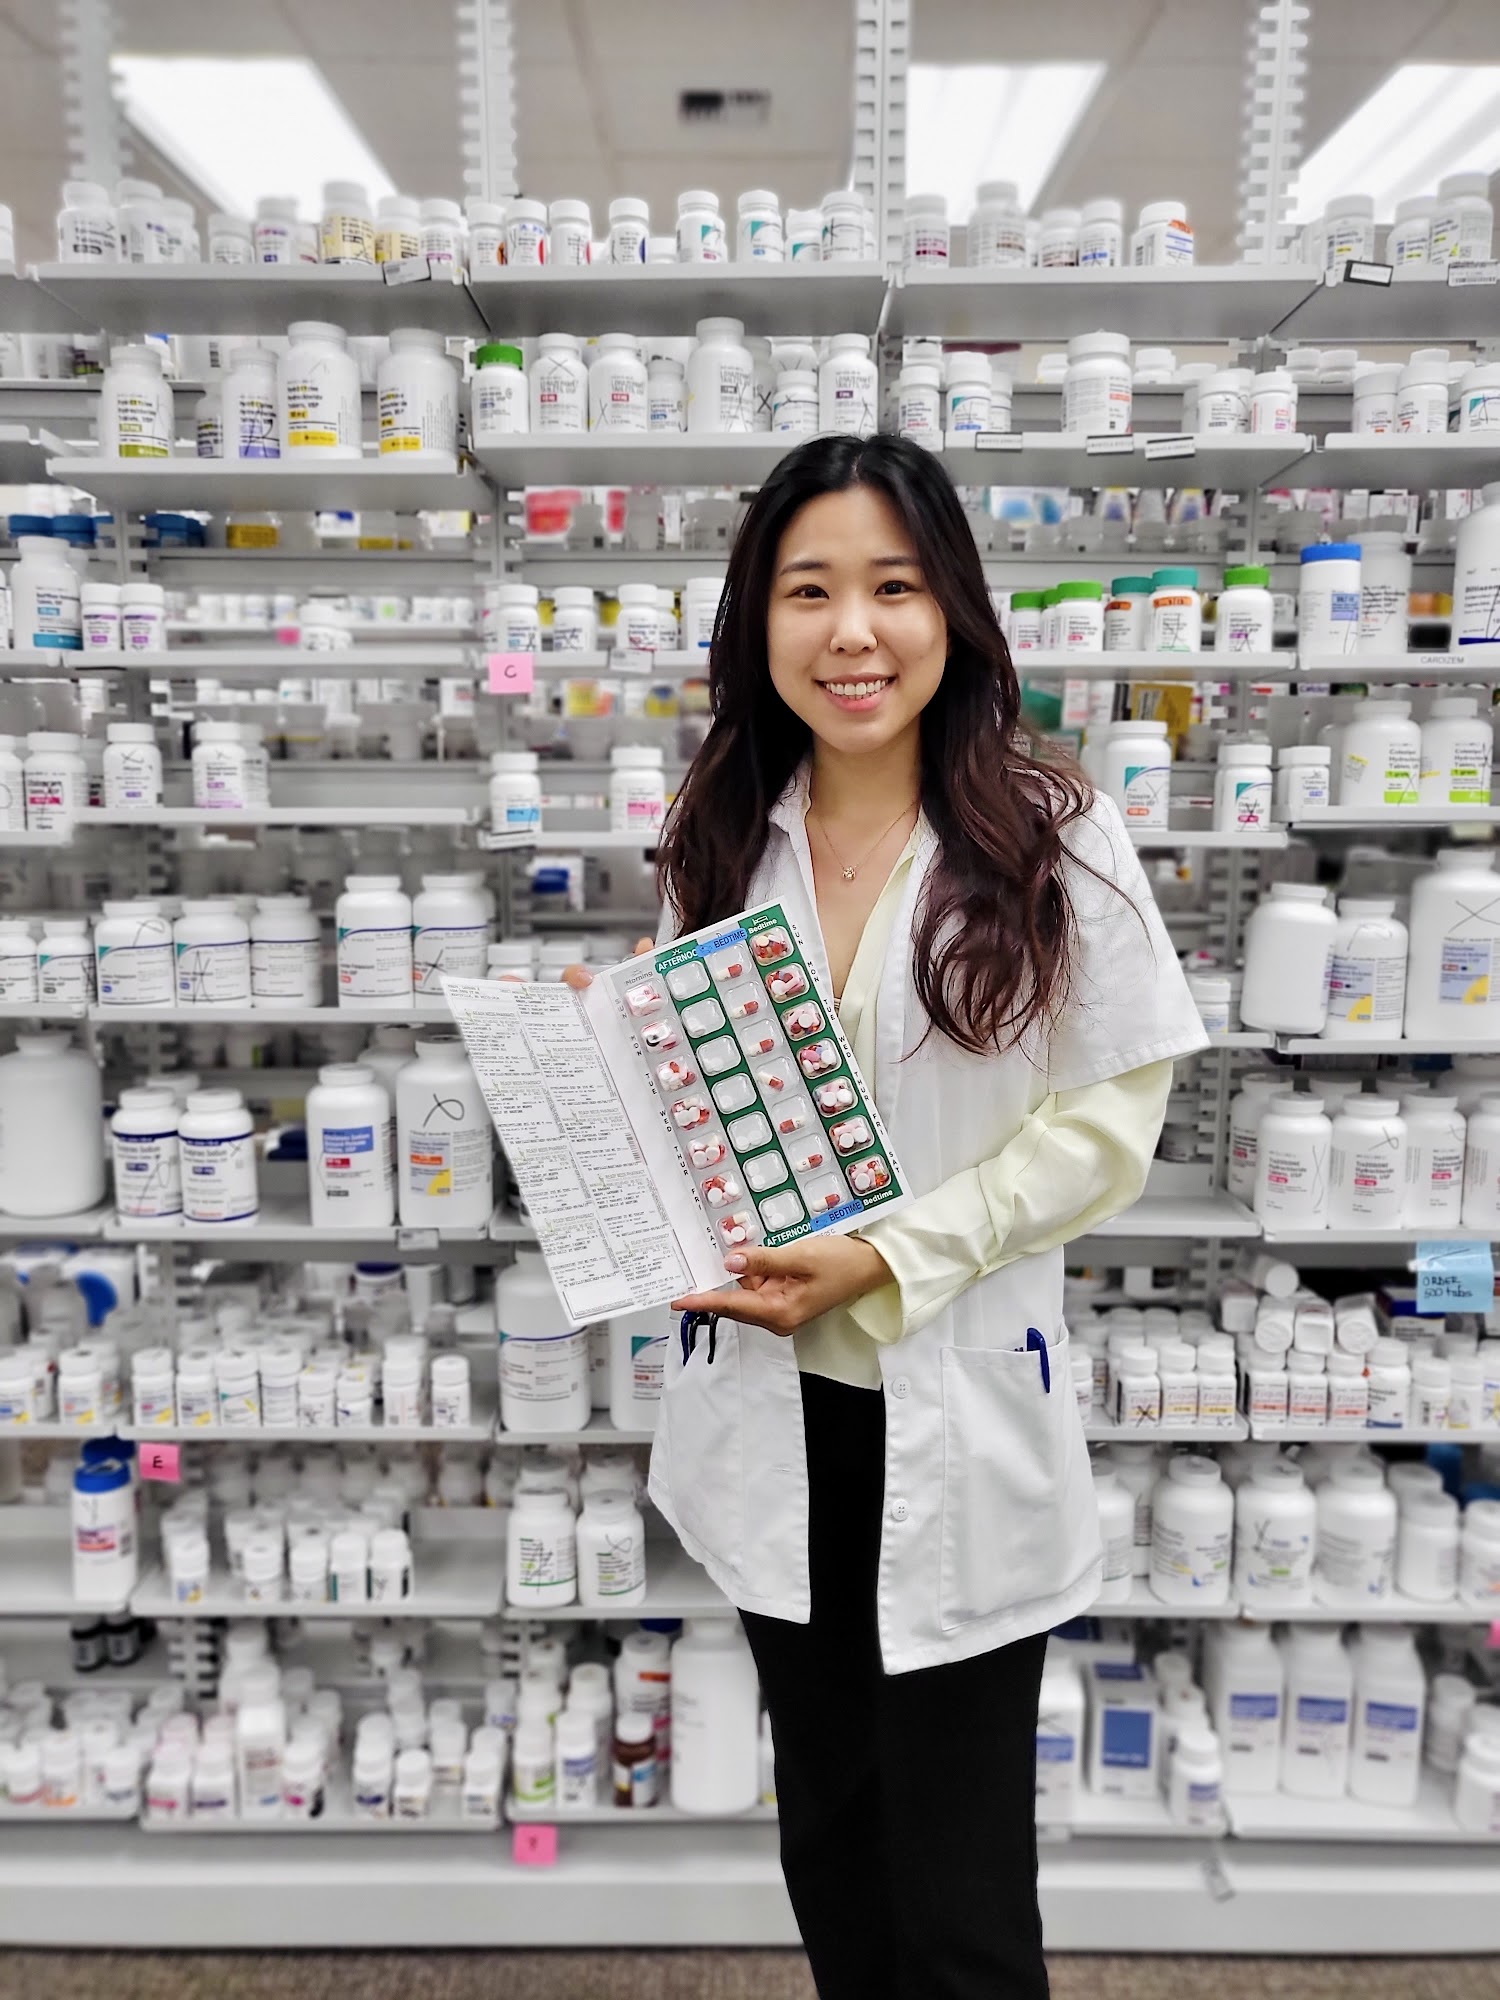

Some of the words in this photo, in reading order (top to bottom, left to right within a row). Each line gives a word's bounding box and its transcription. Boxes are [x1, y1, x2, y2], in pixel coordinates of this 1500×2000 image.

[1420, 656, 1464, 664] CARDIZEM
[504, 664, 517, 679] C
[748, 918, 778, 934] Bedtime
[792, 924, 804, 946] SUN
[713, 930, 746, 949] BEDTIME
[658, 949, 698, 972] AFTERNOO
[625, 971, 654, 986] Morning
[807, 961, 820, 983] MON
[614, 998, 628, 1019] SUN
[823, 999, 836, 1021] TUE
[630, 1034, 642, 1056] MON
[838, 1035, 852, 1058] WED
[645, 1072, 658, 1095] TUE
[853, 1071, 870, 1101] THUR
[659, 1109, 672, 1132] WED
[872, 1113, 885, 1136] FRI
[673, 1145, 689, 1176] THUR
[888, 1151, 901, 1174] SAT
[691, 1188, 702, 1211] FRI
[863, 1189, 894, 1206] Bedtime
[829, 1201, 862, 1222] BEDTIME
[706, 1226, 718, 1249] SAT
[1423, 1275, 1462, 1287] ORDER
[152, 1455, 164, 1469] E
